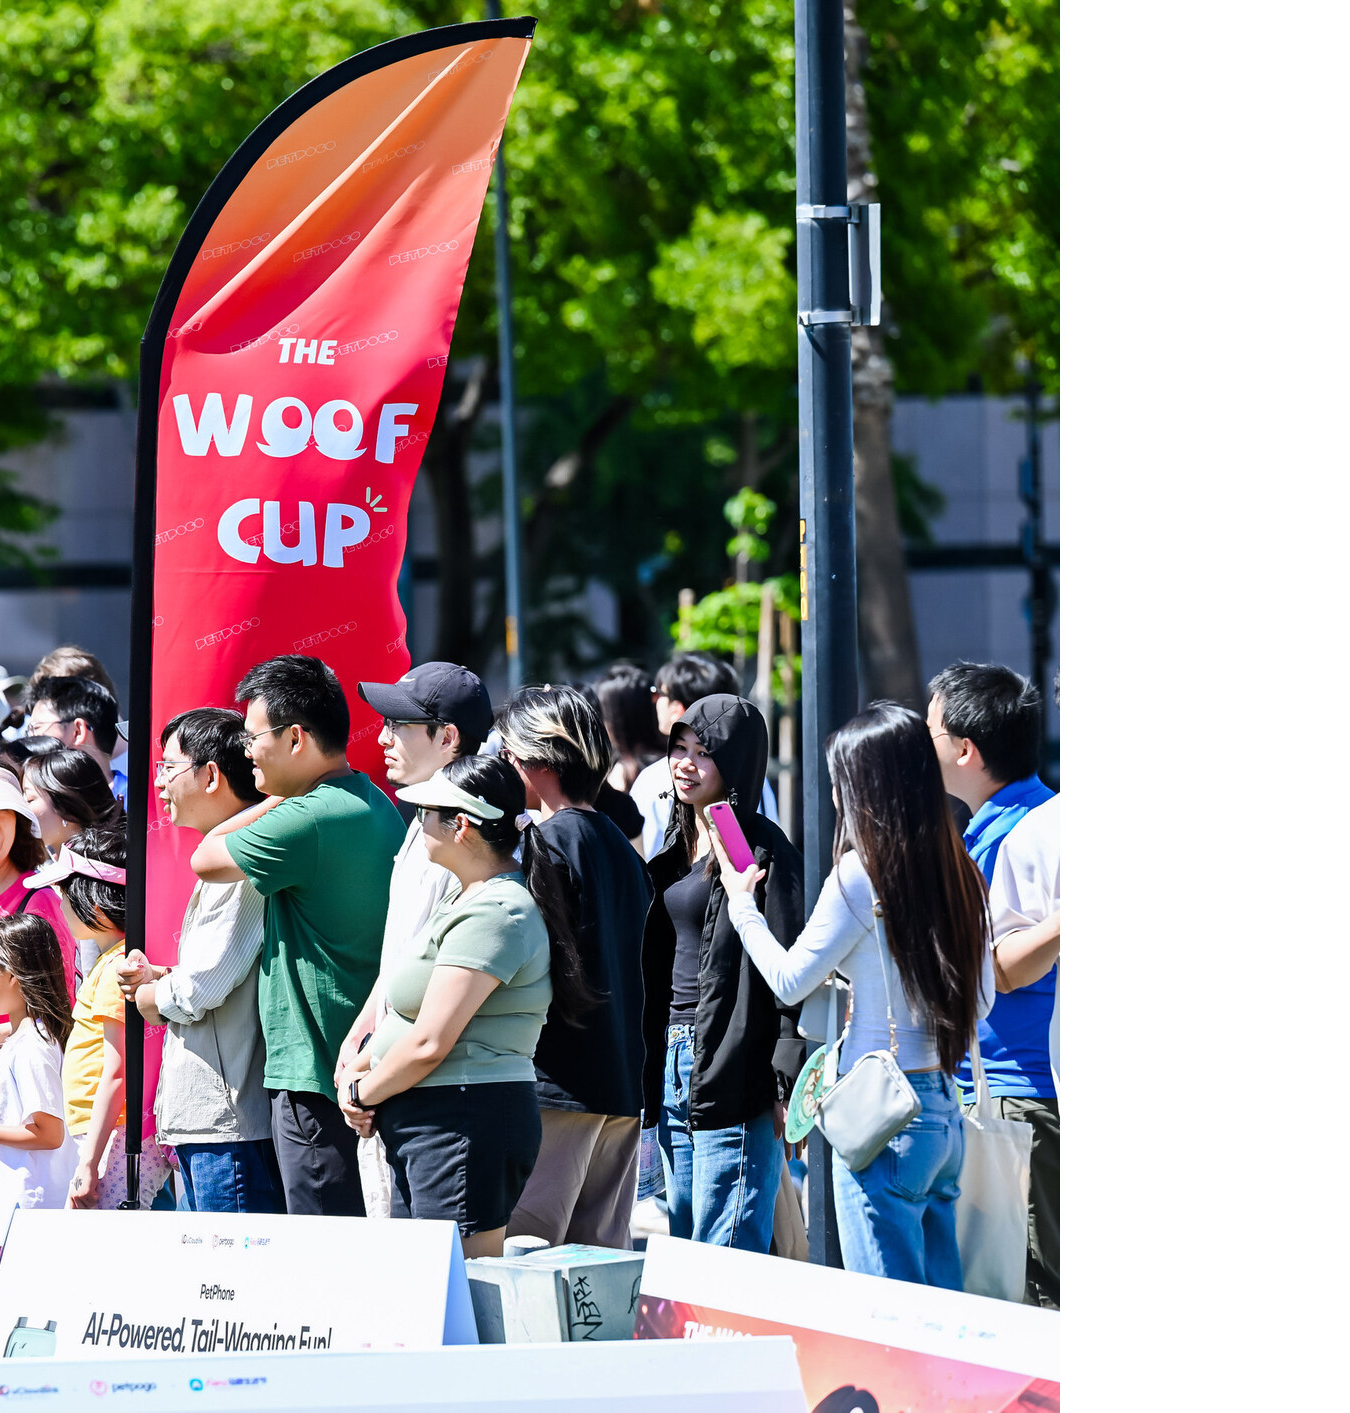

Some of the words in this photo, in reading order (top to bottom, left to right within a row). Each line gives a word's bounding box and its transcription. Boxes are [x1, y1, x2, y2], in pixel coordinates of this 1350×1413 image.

[278, 337, 338, 365] THE
[172, 392, 420, 464] WOOF
[217, 497, 371, 568] CUP
[199, 1283, 235, 1301] PetPhone
[81, 1311, 186, 1353] AI-Powered,
